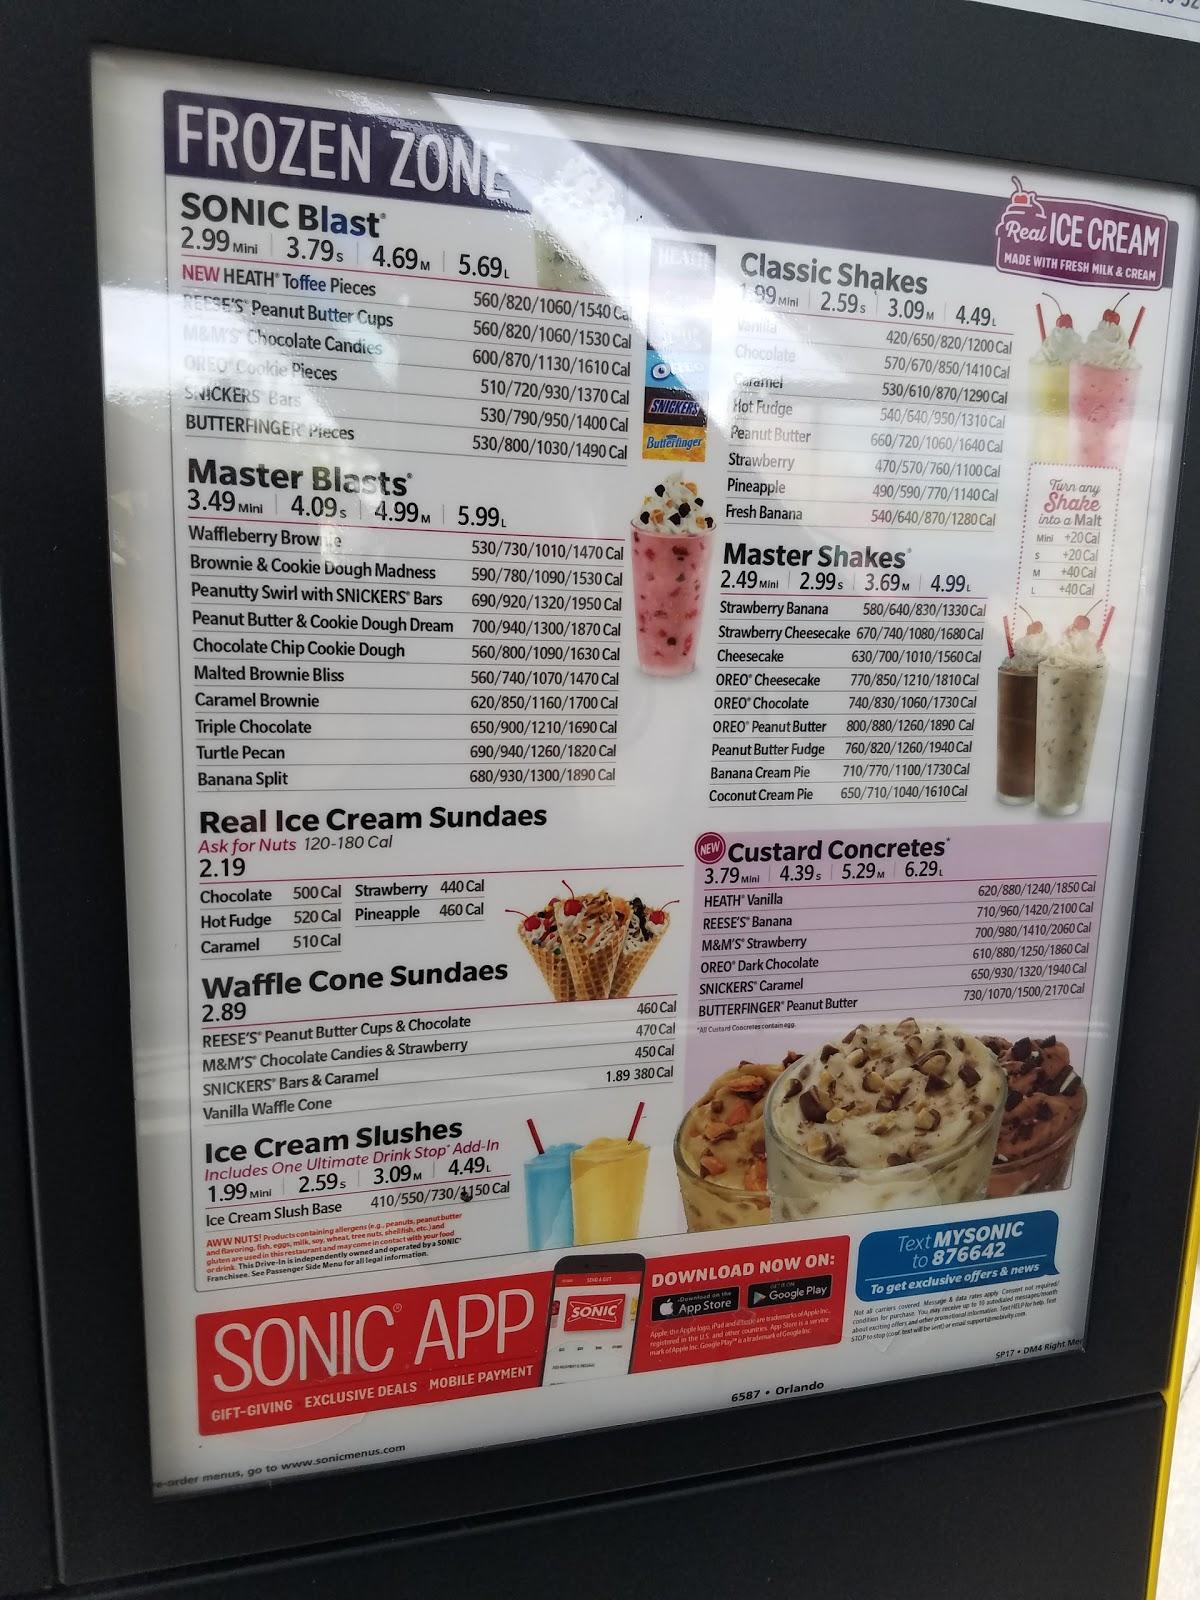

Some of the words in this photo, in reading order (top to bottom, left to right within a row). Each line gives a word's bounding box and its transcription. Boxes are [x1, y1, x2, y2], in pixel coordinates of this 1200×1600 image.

[178, 104, 371, 184] FROZEN
[389, 128, 509, 202] ZONE
[180, 191, 290, 229] SONIC
[1006, 220, 1048, 244] Real
[1049, 212, 1085, 248] ICE
[1087, 217, 1161, 258] CREAM
[740, 252, 833, 285] Classic
[836, 262, 928, 295] Shakes
[1004, 252, 1031, 266] MADE
[1033, 255, 1059, 270] WITH
[1059, 258, 1090, 273] FRESH
[1091, 262, 1114, 277] MILK
[1115, 266, 1124, 278] &
[1124, 267, 1156, 282] CREAM
[182, 264, 221, 283] NEW
[282, 272, 327, 292] Toffee
[330, 277, 376, 297] Pieces
[473, 319, 611, 347] 560/820/1060/1530
[612, 333, 632, 350] Cal
[881, 382, 993, 403] 530/610/870/1290
[991, 390, 1008, 405] Cal
[651, 399, 700, 417] SNICKERS
[472, 434, 607, 459] 530/800/1030/1490
[608, 444, 628, 460] Cal
[647, 435, 702, 451] Butterfinger
[728, 452, 794, 472] Strawberry
[188, 458, 304, 490] Master
[727, 477, 786, 497] Pineapple
[1049, 478, 1077, 492] Turn
[1078, 484, 1102, 498] any
[1043, 491, 1101, 512] Shake
[1037, 513, 1062, 526] into
[1063, 517, 1073, 526] a
[1074, 512, 1103, 527] Malt
[1036, 533, 1054, 543] Mini
[1064, 530, 1085, 544] +20
[1084, 531, 1101, 545] Cal
[723, 542, 813, 567] Master
[190, 553, 253, 571] Brownie
[256, 556, 268, 572] &
[271, 557, 321, 575] Cookie
[324, 560, 372, 580] Dough
[375, 562, 436, 580] Madness
[471, 566, 603, 587] 590/780/1090/1530
[604, 572, 623, 587] Cal
[194, 664, 246, 681] Malted
[249, 666, 310, 682] Brownie
[312, 667, 345, 682] Bliss
[470, 669, 599, 687] 560/740/1070/1470
[601, 671, 619, 686] Cal
[198, 772, 253, 787] Banana
[255, 771, 289, 789] Split
[708, 789, 758, 802] Coconut
[758, 788, 795, 801] Cream
[796, 787, 814, 800] Pie
[199, 809, 267, 834] Real
[276, 809, 320, 832] Ice
[326, 808, 422, 831] Cream
[429, 804, 548, 829] Sundaes
[197, 838, 229, 854] Ask
[231, 838, 256, 857] for
[259, 838, 297, 852] Nuts
[305, 835, 365, 851] 120-180
[367, 834, 393, 849] Cal
[700, 841, 721, 856] NEW
[727, 839, 823, 863] Custard
[199, 857, 246, 878] 2.19
[746, 892, 783, 906] Vanilla
[977, 881, 1080, 898] 620/880/1240/1850
[1080, 880, 1097, 893] Cal
[201, 914, 227, 929] Hot
[229, 912, 272, 929] Fudge
[293, 910, 319, 924] 520
[320, 908, 342, 923] Cal
[737, 958, 764, 972] Dark
[765, 956, 819, 971] Chocolate
[201, 972, 302, 1000] Waffle
[308, 970, 384, 993] Cone
[389, 961, 508, 987] Sundaes
[201, 1001, 247, 1023] 2.89
[606, 1069, 631, 1083] 1.89
[633, 1067, 658, 1080] 380
[656, 1065, 674, 1079] Cal
[202, 1103, 249, 1120] Vanilla
[251, 1099, 295, 1116] Waffle
[297, 1098, 333, 1112] Cone
[205, 1143, 248, 1164] Ice
[254, 1134, 349, 1159] Cream
[355, 1121, 463, 1149] Slushes
[205, 1164, 268, 1182] Includes
[271, 1161, 303, 1175] One
[306, 1154, 369, 1171] Ultimate
[372, 1147, 412, 1164] Drink
[206, 1214, 225, 1227] Ice
[228, 1211, 272, 1224] Cream
[274, 1203, 309, 1220] Slush
[312, 1202, 343, 1216] Base
[206, 1237, 233, 1248] AWW
[234, 1233, 262, 1245] NUTS!
[263, 1232, 296, 1242] Products
[898, 1234, 932, 1253] Text
[932, 1220, 1025, 1249] MYSONIC
[912, 1254, 929, 1269] to
[931, 1241, 1006, 1266] 876642
[265, 1266, 304, 1276] Passenger
[305, 1262, 322, 1271] Side
[322, 1261, 343, 1269] Menu
[651, 1262, 755, 1288] DOWNLOAD
[759, 1256, 802, 1274] NOW
[805, 1252, 835, 1269] ON:
[871, 1283, 885, 1295] To
[885, 1280, 908, 1295] get
[908, 1273, 963, 1290] exclusive
[963, 1269, 999, 1284] offers
[999, 1266, 1009, 1277] &
[1010, 1263, 1040, 1276] news
[768, 1287, 805, 1301] Google
[806, 1285, 828, 1296] Play
[571, 1304, 617, 1318] SONIC
[678, 1303, 702, 1315] App
[703, 1299, 732, 1311] Store
[413, 1288, 535, 1366] APP
[995, 1350, 1015, 1360] SP17
[1024, 1346, 1043, 1355] DM4
[1044, 1341, 1066, 1351] Right
[212, 1399, 293, 1422] GIFT-GIVING
[304, 1386, 375, 1409] EXCLUSIVE
[377, 1381, 418, 1398] DEALS
[429, 1372, 475, 1390] MOBILE
[477, 1364, 534, 1384] PAYMENT
[731, 1389, 761, 1402] 6587
[775, 1381, 824, 1395] Orlando
[203, 1468, 244, 1484] menus,
[248, 1466, 262, 1478] go
[266, 1463, 277, 1473] to
[281, 1443, 406, 1471] www.sonicmenus.com
